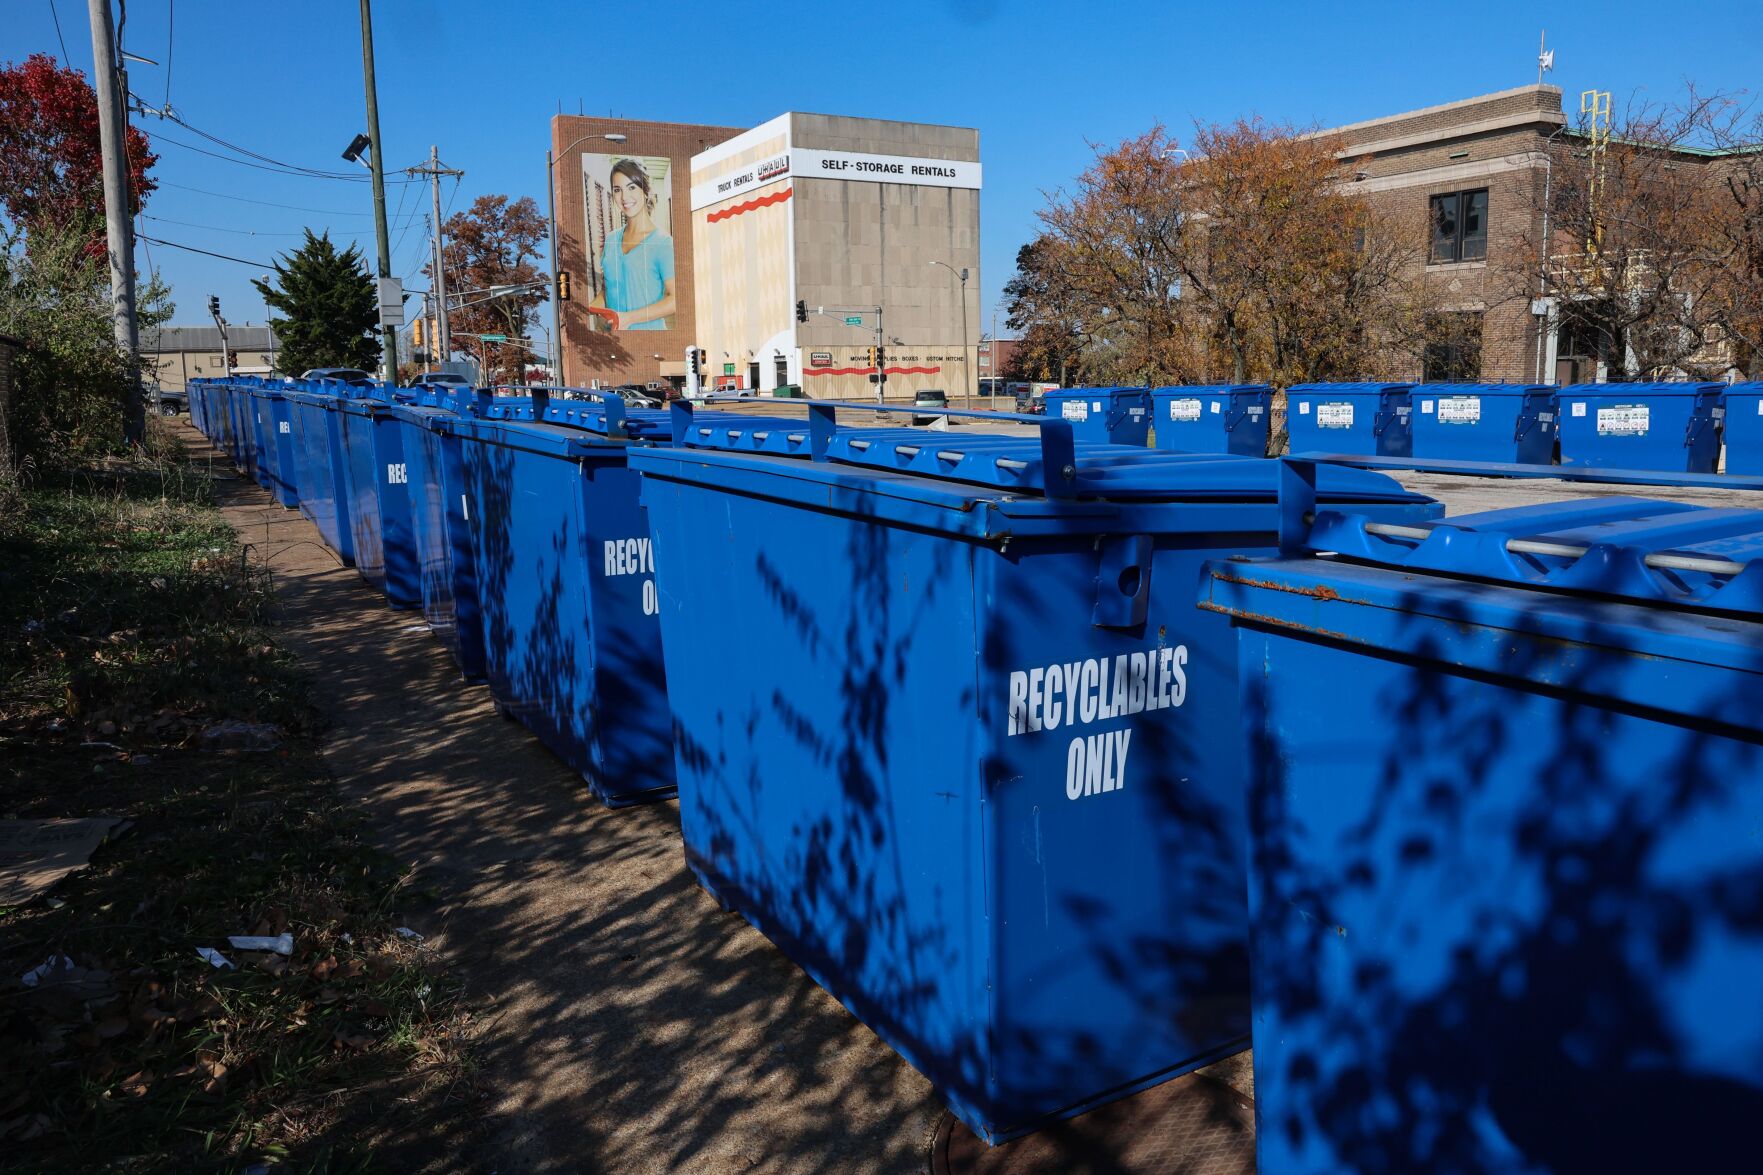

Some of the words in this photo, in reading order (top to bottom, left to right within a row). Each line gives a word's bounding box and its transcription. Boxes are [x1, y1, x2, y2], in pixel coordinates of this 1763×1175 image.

[717, 181, 732, 193] TRUCK
[733, 173, 754, 187] RENTALS
[911, 165, 956, 178] RENTALS
[1007, 644, 1189, 737] RECYCLABLES
[1065, 728, 1132, 801] ONLY
